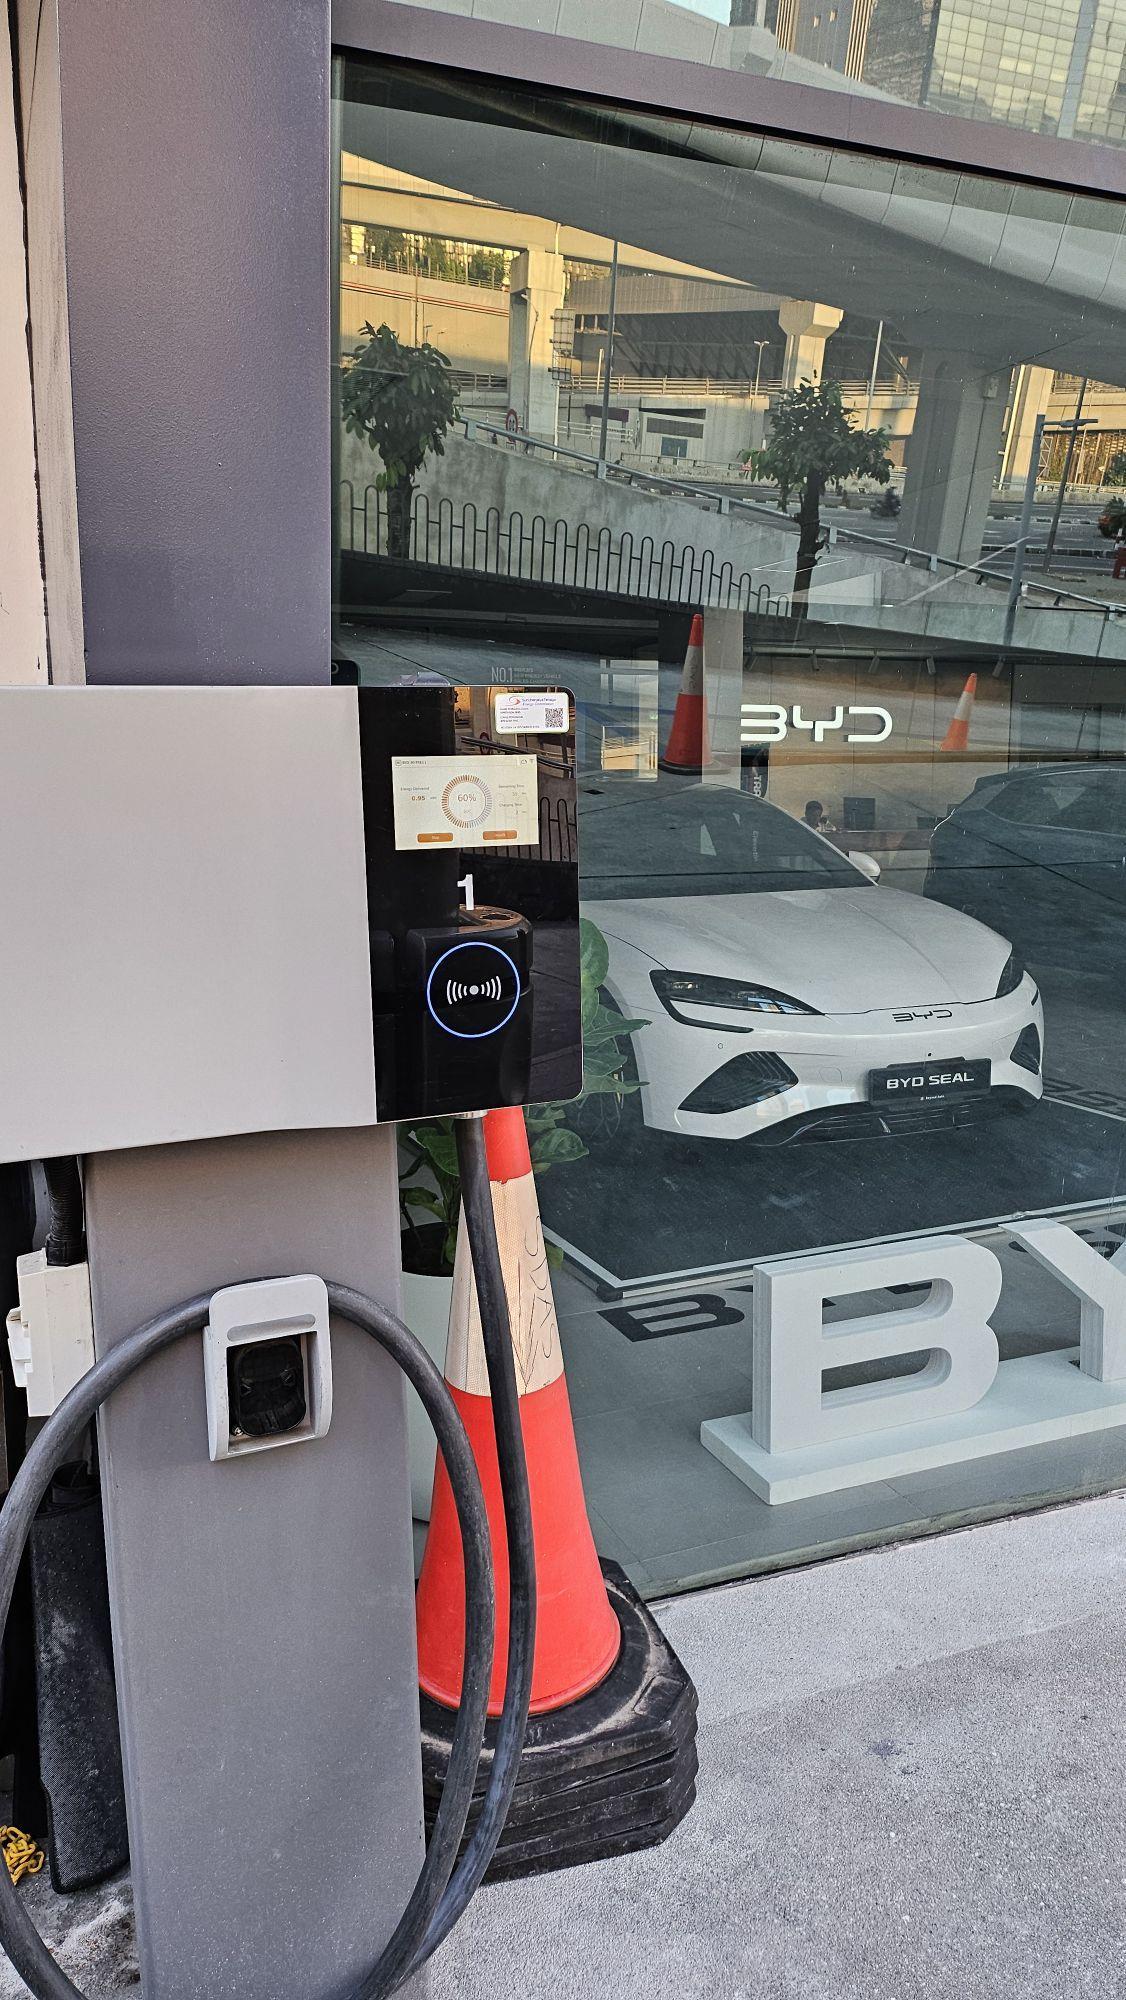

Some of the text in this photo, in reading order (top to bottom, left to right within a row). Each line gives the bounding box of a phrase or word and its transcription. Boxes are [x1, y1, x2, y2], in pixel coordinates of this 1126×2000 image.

[491, 666, 513, 684] NO.1
[740, 704, 893, 742] BYD
[457, 793, 477, 802] 60%
[457, 873, 475, 910] 1
[892, 1009, 953, 1022] BYD
[886, 1072, 975, 1089] BYD SEAL
